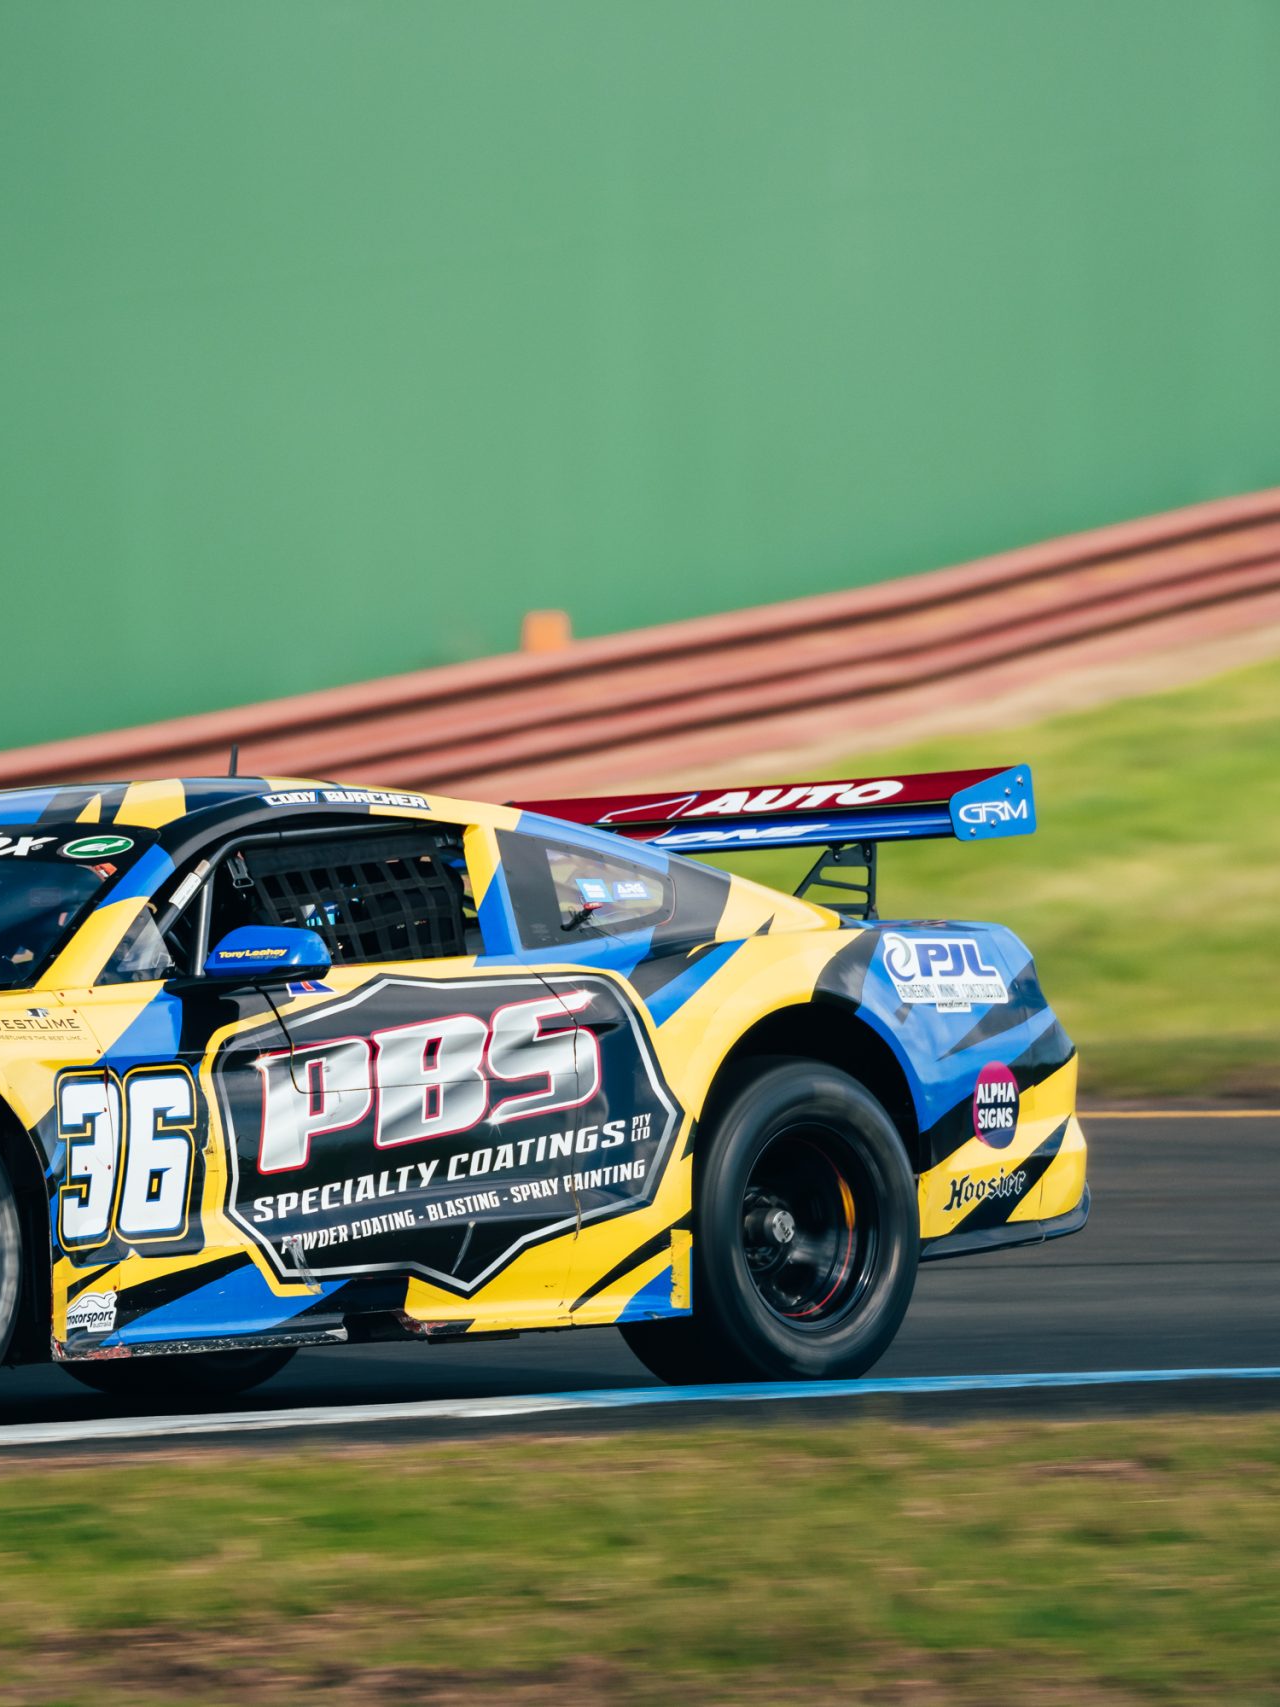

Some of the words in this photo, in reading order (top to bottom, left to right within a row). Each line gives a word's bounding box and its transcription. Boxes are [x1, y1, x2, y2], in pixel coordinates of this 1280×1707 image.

[262, 791, 317, 806] CODY
[322, 790, 430, 810] BURCHER
[682, 780, 903, 816] AUTO
[959, 799, 1027, 823] GRM
[219, 950, 245, 959] Tony
[915, 943, 996, 977] PJL
[257, 990, 602, 1175] PBS
[976, 1081, 1016, 1104] ALPHA
[631, 1113, 651, 1129] PTY
[977, 1107, 1013, 1129] SIGNS
[631, 1126, 650, 1142] LTD
[58, 1068, 195, 1248] 36
[253, 1158, 440, 1223] SPECIALTY
[446, 1119, 626, 1182] COATINGS
[351, 1209, 416, 1240] COATING
[426, 1190, 500, 1222] BLASTING
[510, 1177, 559, 1204] SPRAY
[563, 1159, 645, 1193] PAINTING
[942, 1167, 1027, 1211] Hoosier
